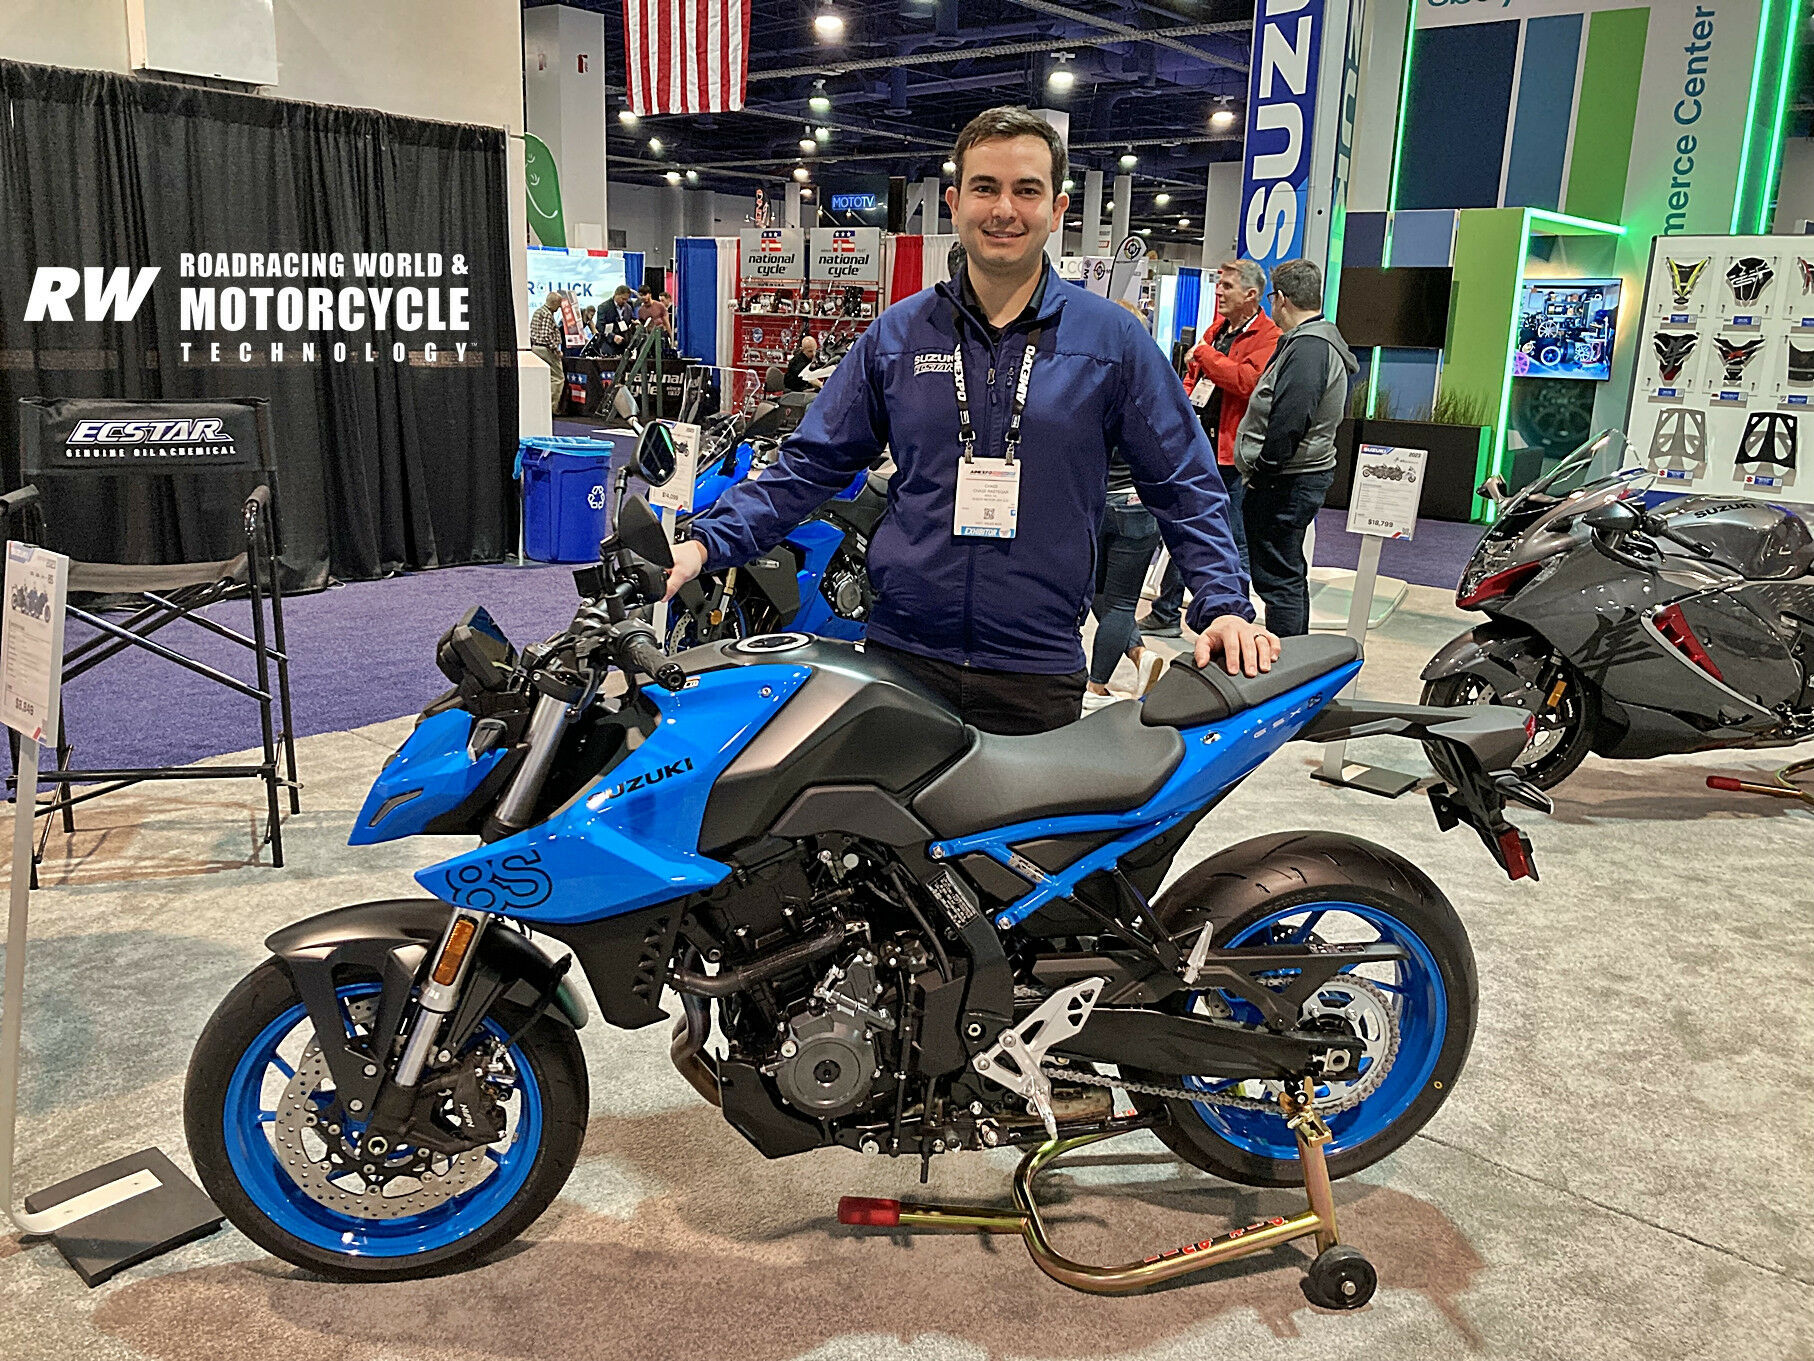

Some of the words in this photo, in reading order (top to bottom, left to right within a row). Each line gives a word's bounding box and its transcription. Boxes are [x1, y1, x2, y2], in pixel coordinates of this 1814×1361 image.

[1673, 5, 1716, 125] Center
[1245, 0, 1313, 260] SUZ
[748, 253, 795, 264] national
[818, 254, 870, 265] national
[757, 264, 786, 277] cycle
[828, 265, 859, 278] cycle
[914, 353, 955, 365] SUZUK
[624, 371, 685, 384] nainal
[66, 417, 235, 445] ECSTAR
[1363, 446, 1387, 454] SUZUKI
[1693, 502, 1757, 519] SUZUKI
[586, 757, 694, 810] UZUKI
